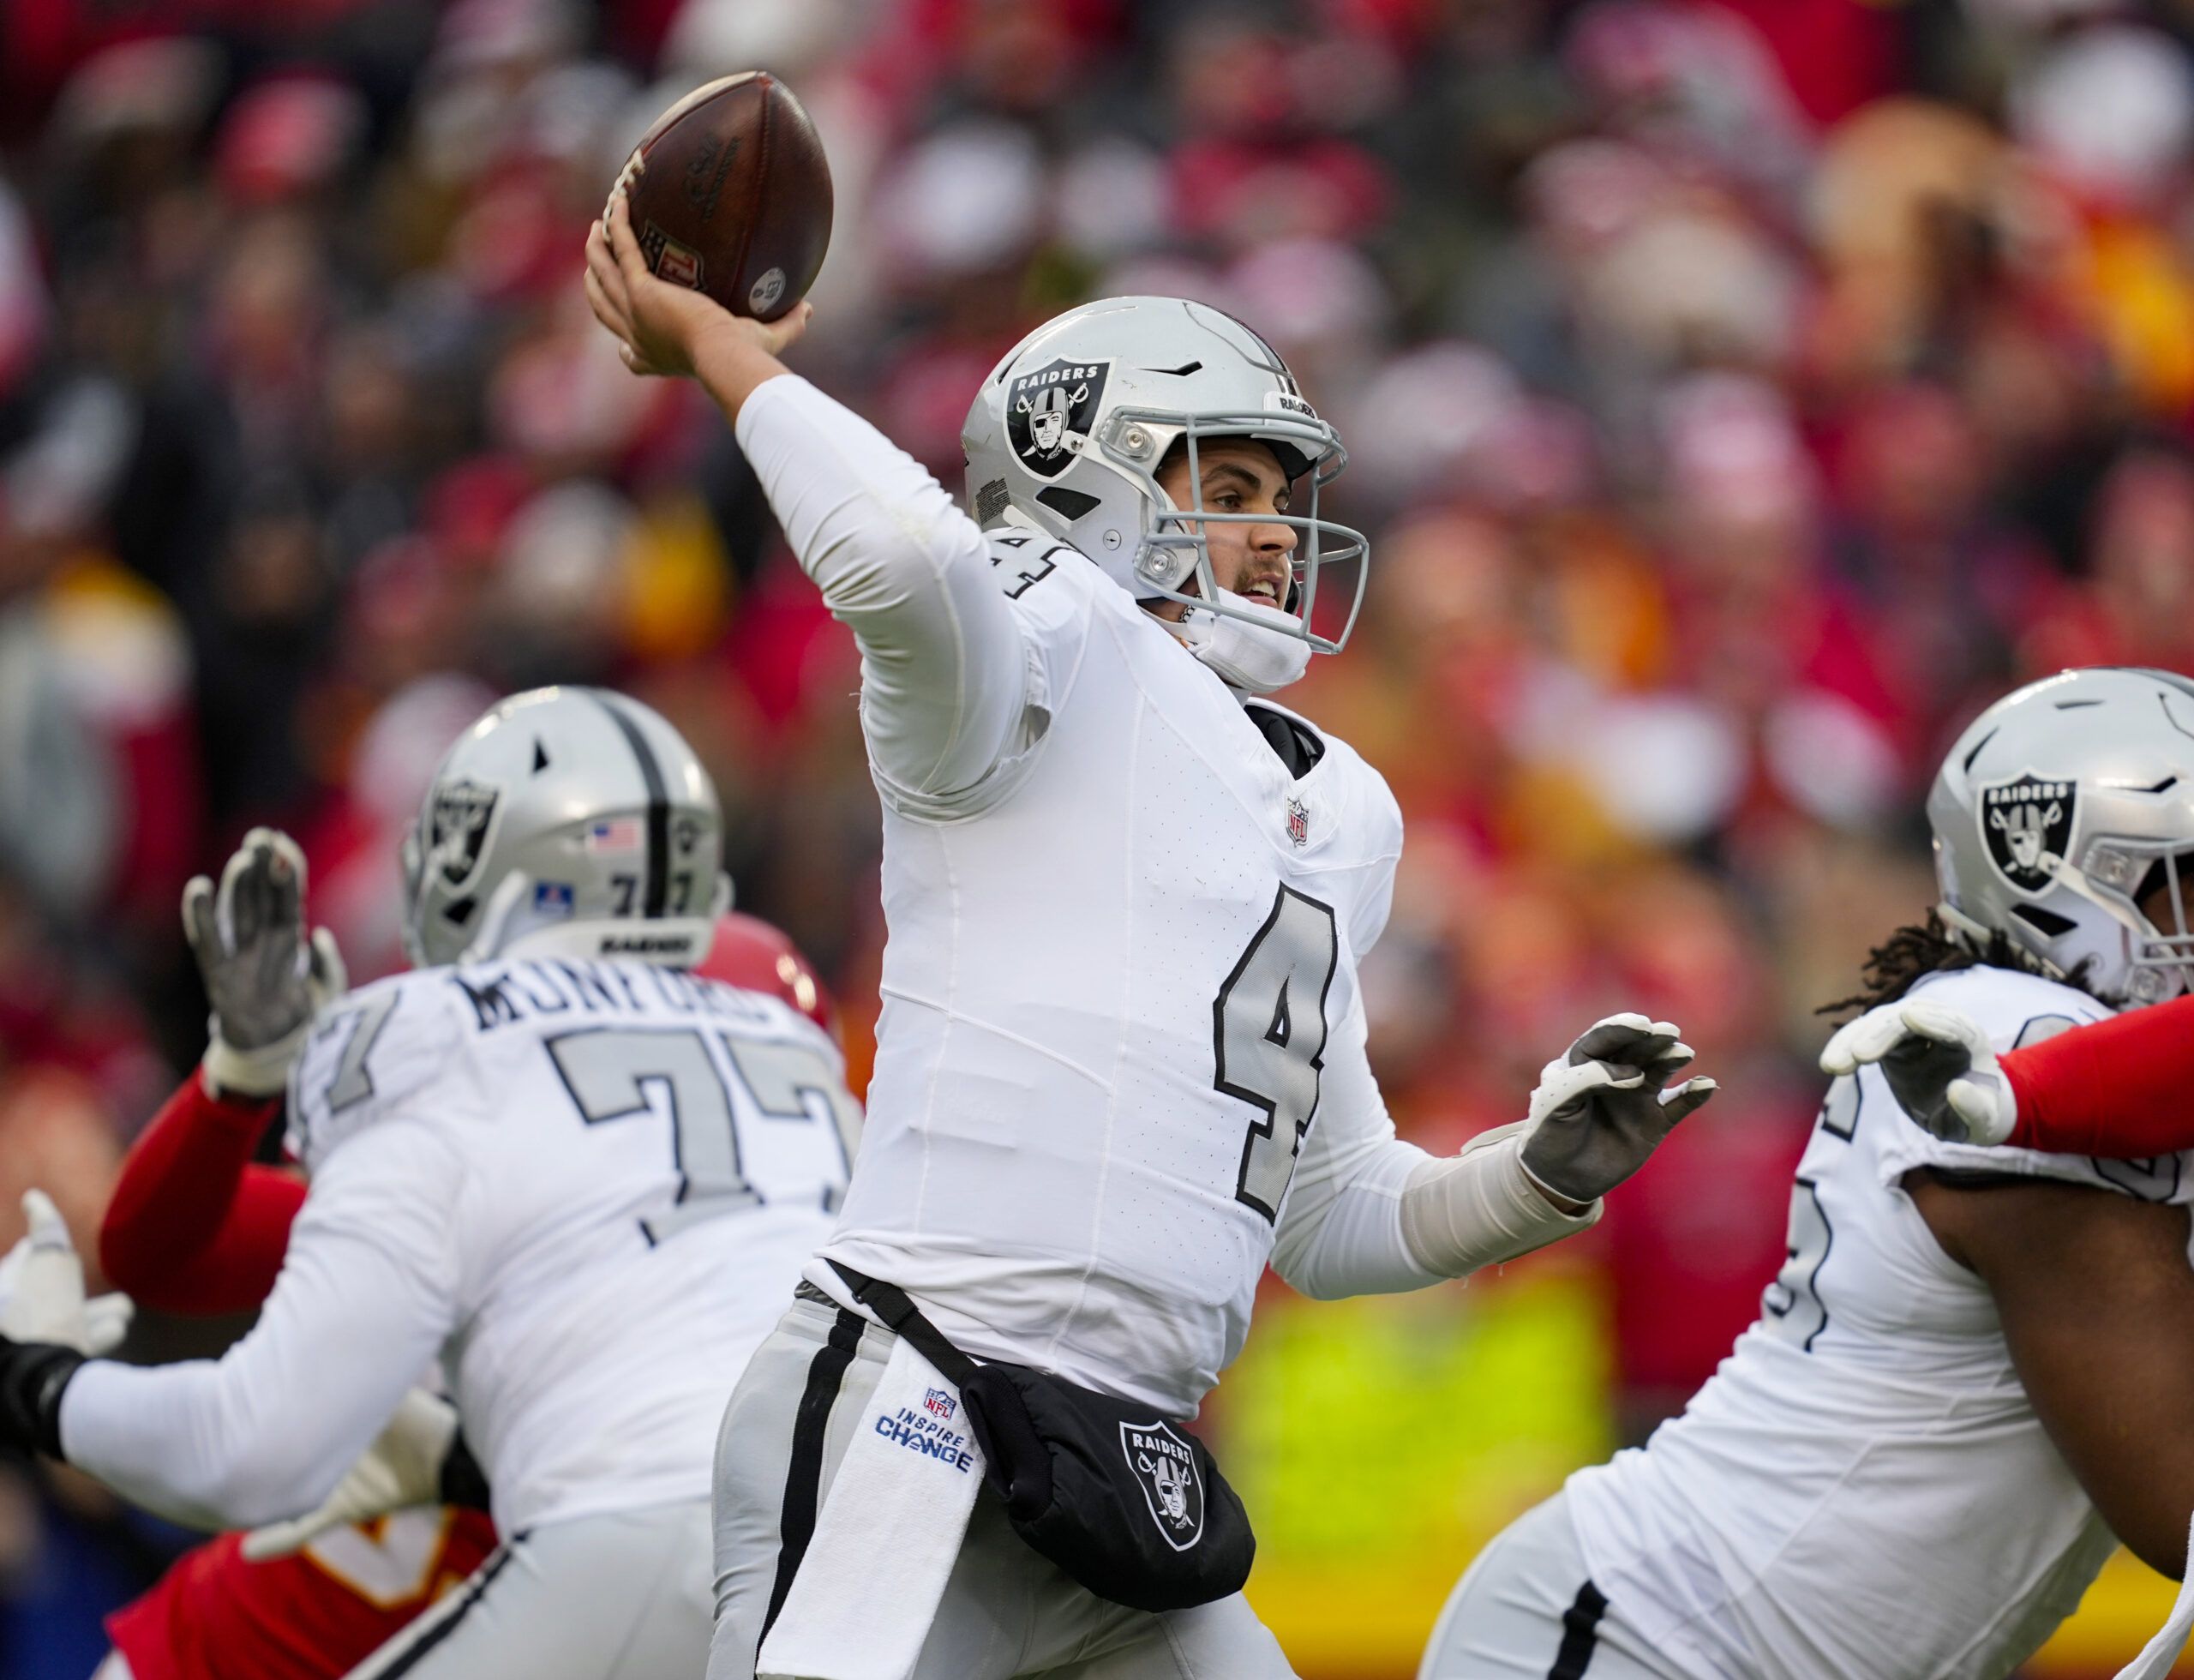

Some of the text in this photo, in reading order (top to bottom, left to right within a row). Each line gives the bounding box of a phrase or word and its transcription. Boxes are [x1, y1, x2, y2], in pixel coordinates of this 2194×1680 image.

[1017, 366, 1098, 391] RAIDERS
[1280, 398, 1315, 418] RAIDERS
[1987, 783, 2067, 804] RAIDERS
[1290, 813, 1305, 837] NFL
[1213, 880, 1338, 1227] 4
[543, 1025, 862, 1247] 77
[925, 1398, 949, 1419] NFL
[896, 1407, 964, 1447] INSPIRE
[875, 1415, 974, 1473] CHANGE
[1133, 1433, 1190, 1465] RAIDERS
